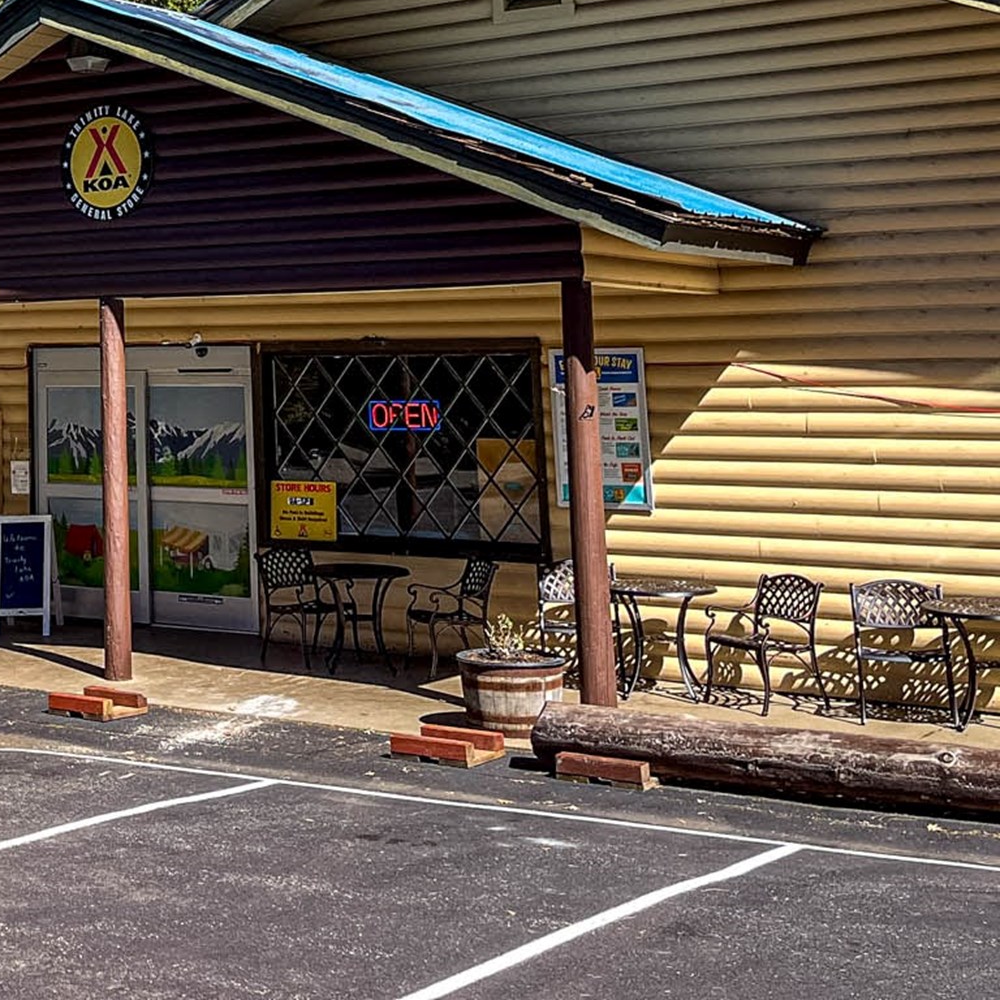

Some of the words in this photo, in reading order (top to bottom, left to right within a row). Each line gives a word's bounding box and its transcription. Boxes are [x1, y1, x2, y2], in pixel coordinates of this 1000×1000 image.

[69, 105, 110, 138] TRINITY
[116, 106, 141, 131] LAKE
[83, 175, 130, 193] KOA
[70, 193, 112, 220] GENERAL
[116, 185, 144, 217] STORE
[611, 356, 633, 370] STAY
[372, 403, 437, 428] OPEN
[275, 483, 301, 492] STORE
[304, 484, 332, 493] HOURS
